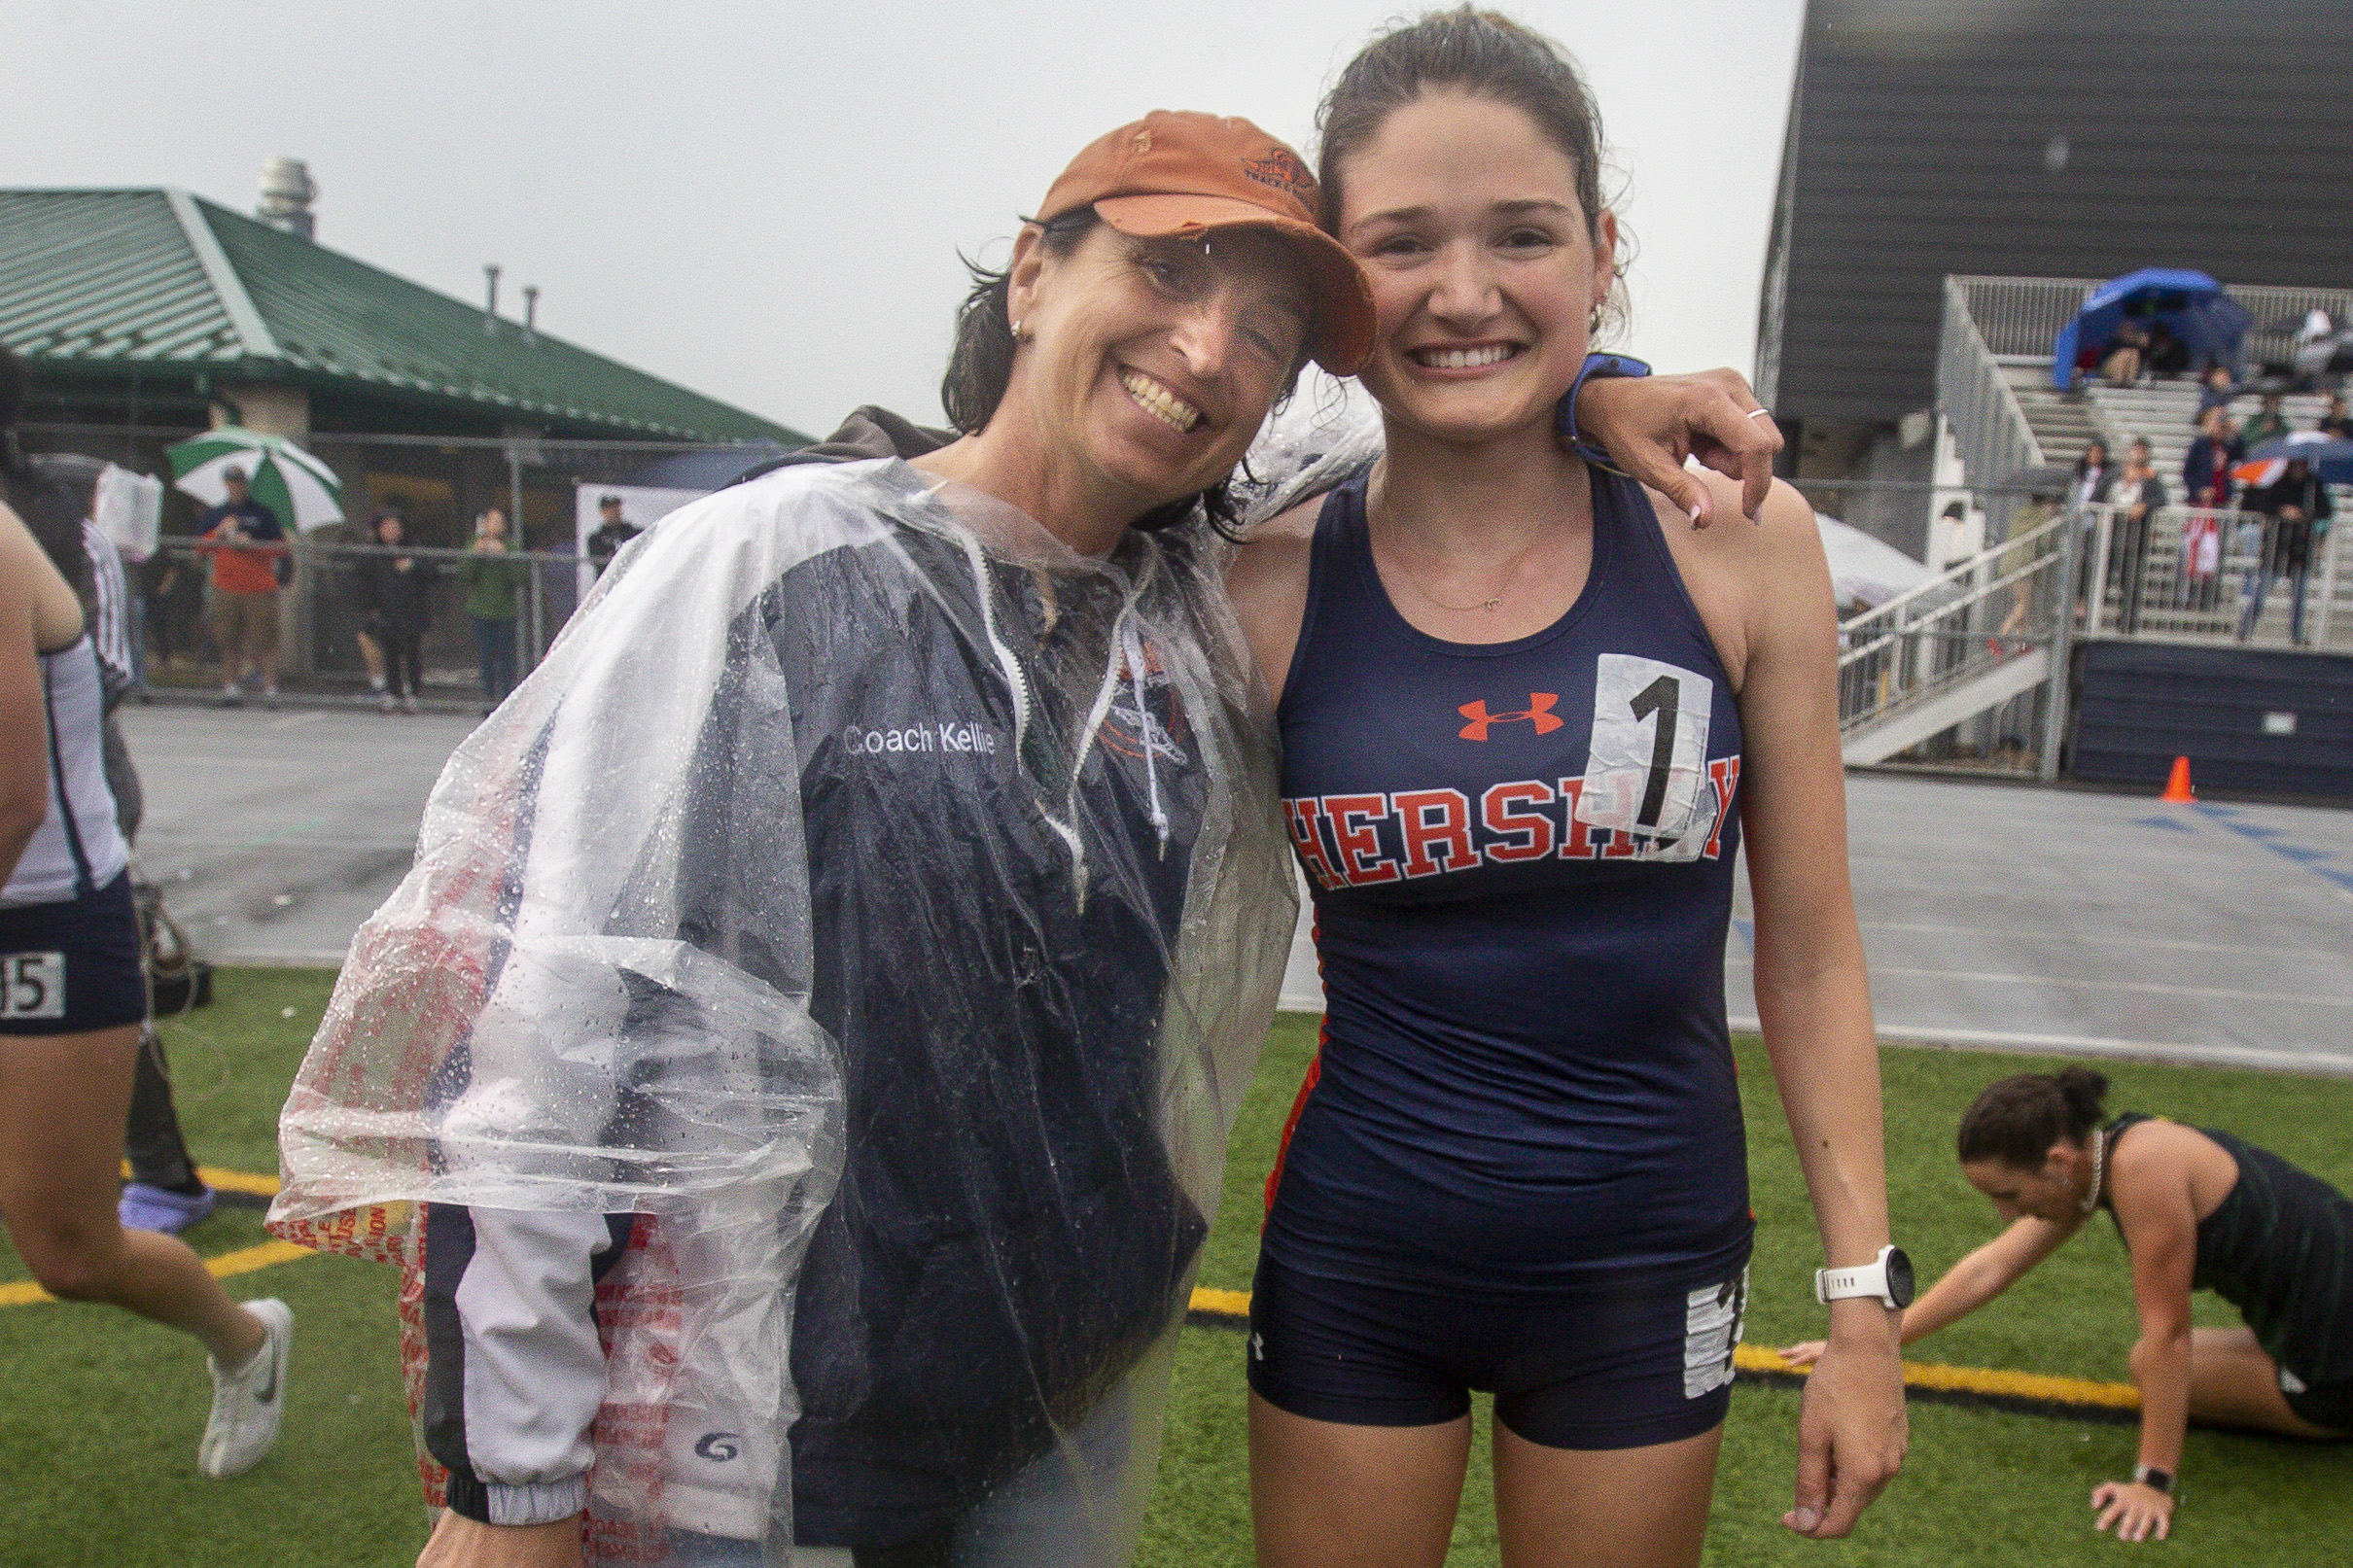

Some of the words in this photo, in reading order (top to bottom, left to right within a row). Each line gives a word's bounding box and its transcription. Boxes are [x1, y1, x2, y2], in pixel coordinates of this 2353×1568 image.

[844, 722, 933, 754] Coach
[939, 721, 995, 755] Kellie
[1630, 675, 1680, 827] 1
[1282, 754, 1740, 890] HERSHY
